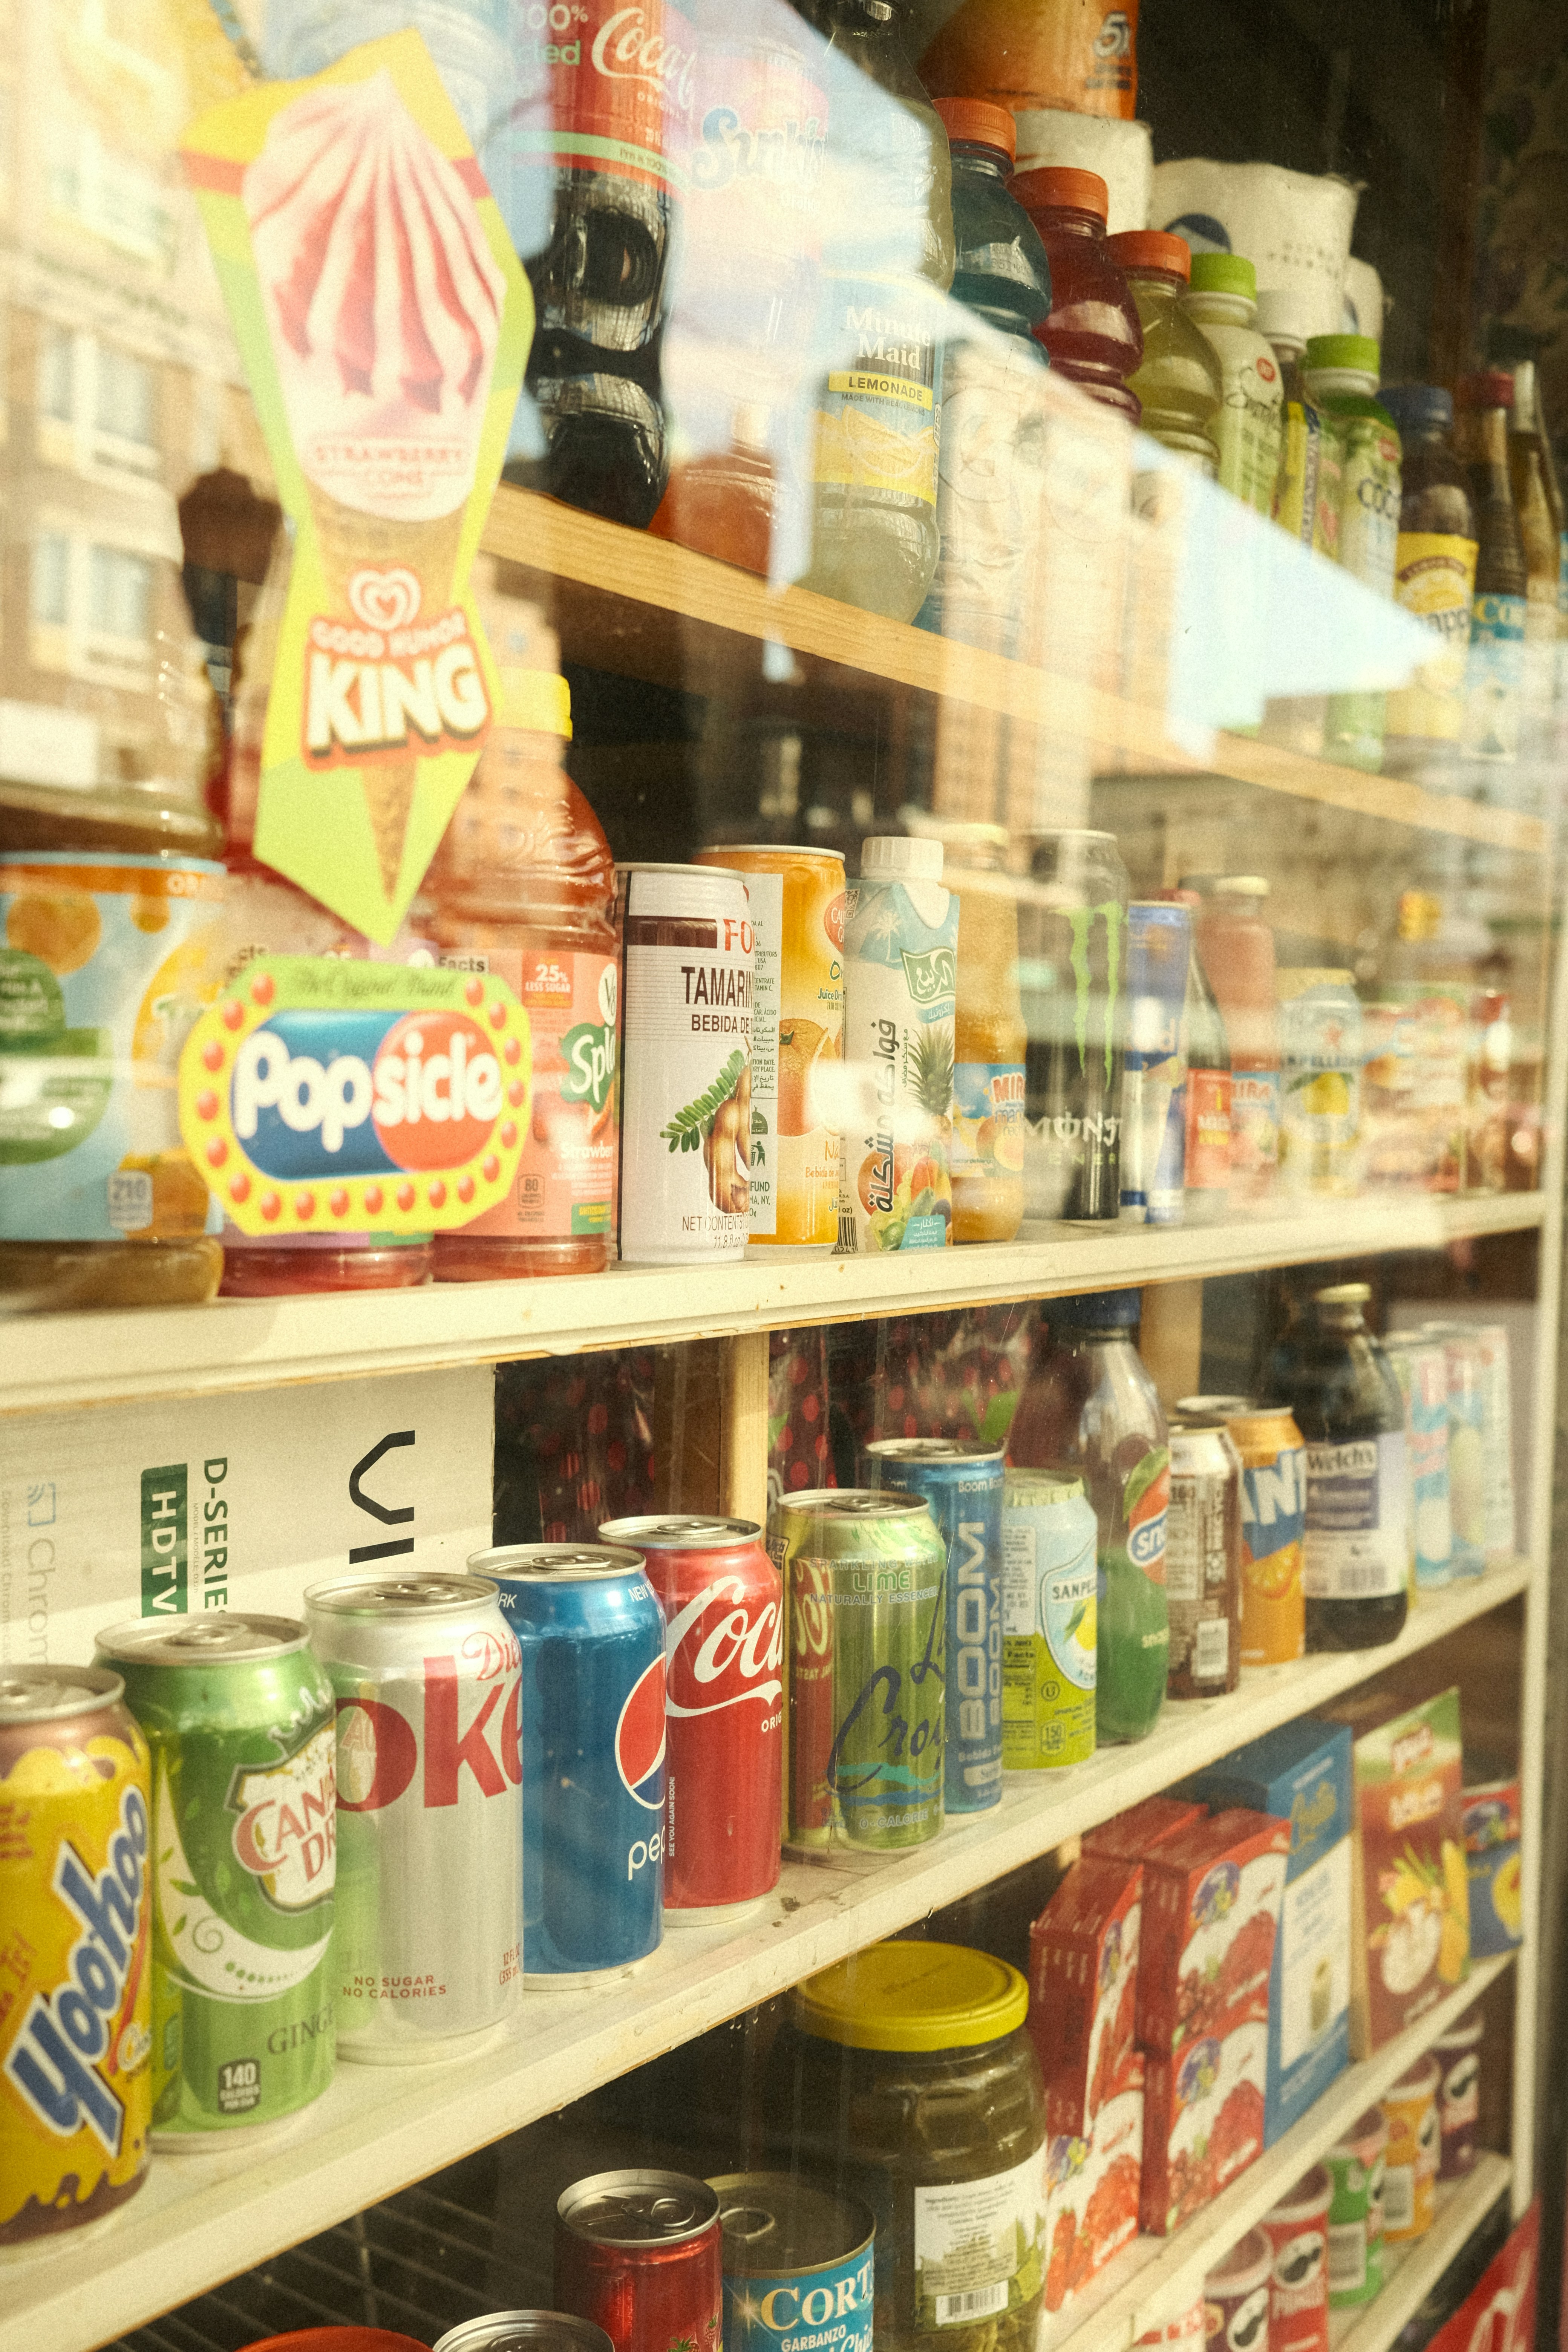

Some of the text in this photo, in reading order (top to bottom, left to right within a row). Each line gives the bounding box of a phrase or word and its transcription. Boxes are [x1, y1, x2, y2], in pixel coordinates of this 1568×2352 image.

[845, 305, 931, 346] Minute
[856, 333, 921, 371] Maid
[848, 376, 922, 402] LEMONADE
[841, 393, 864, 403] MADE
[865, 396, 885, 406] WITH
[308, 644, 488, 750] KING
[535, 963, 568, 983] 25%
[818, 987, 834, 1000] Juice
[691, 1014, 749, 1034] BEBIDA DE
[233, 1031, 502, 1153] Popsicle
[805, 1166, 828, 1178] Bebida
[761, 1195, 770, 1205] NY,
[682, 1216, 702, 1231] NET
[959, 1481, 987, 1492] Boom
[204, 1457, 228, 1613] D-SERIE
[150, 1491, 178, 1612] HDTV
[810, 1558, 897, 1571] SPARKLING
[853, 1570, 911, 1592] LIME
[628, 1584, 649, 1603] NEW
[810, 1592, 884, 1606] NATURALLY
[956, 1521, 987, 1741] BOOM
[877, 1808, 929, 1828] CALORIE
[503, 1951, 509, 1966] 12
[354, 1974, 434, 1988] NO SUGAR
[343, 1984, 447, 2000] NO CALORIES
[225, 2062, 256, 2089] 140
[781, 2324, 847, 2352] GARBANZO
